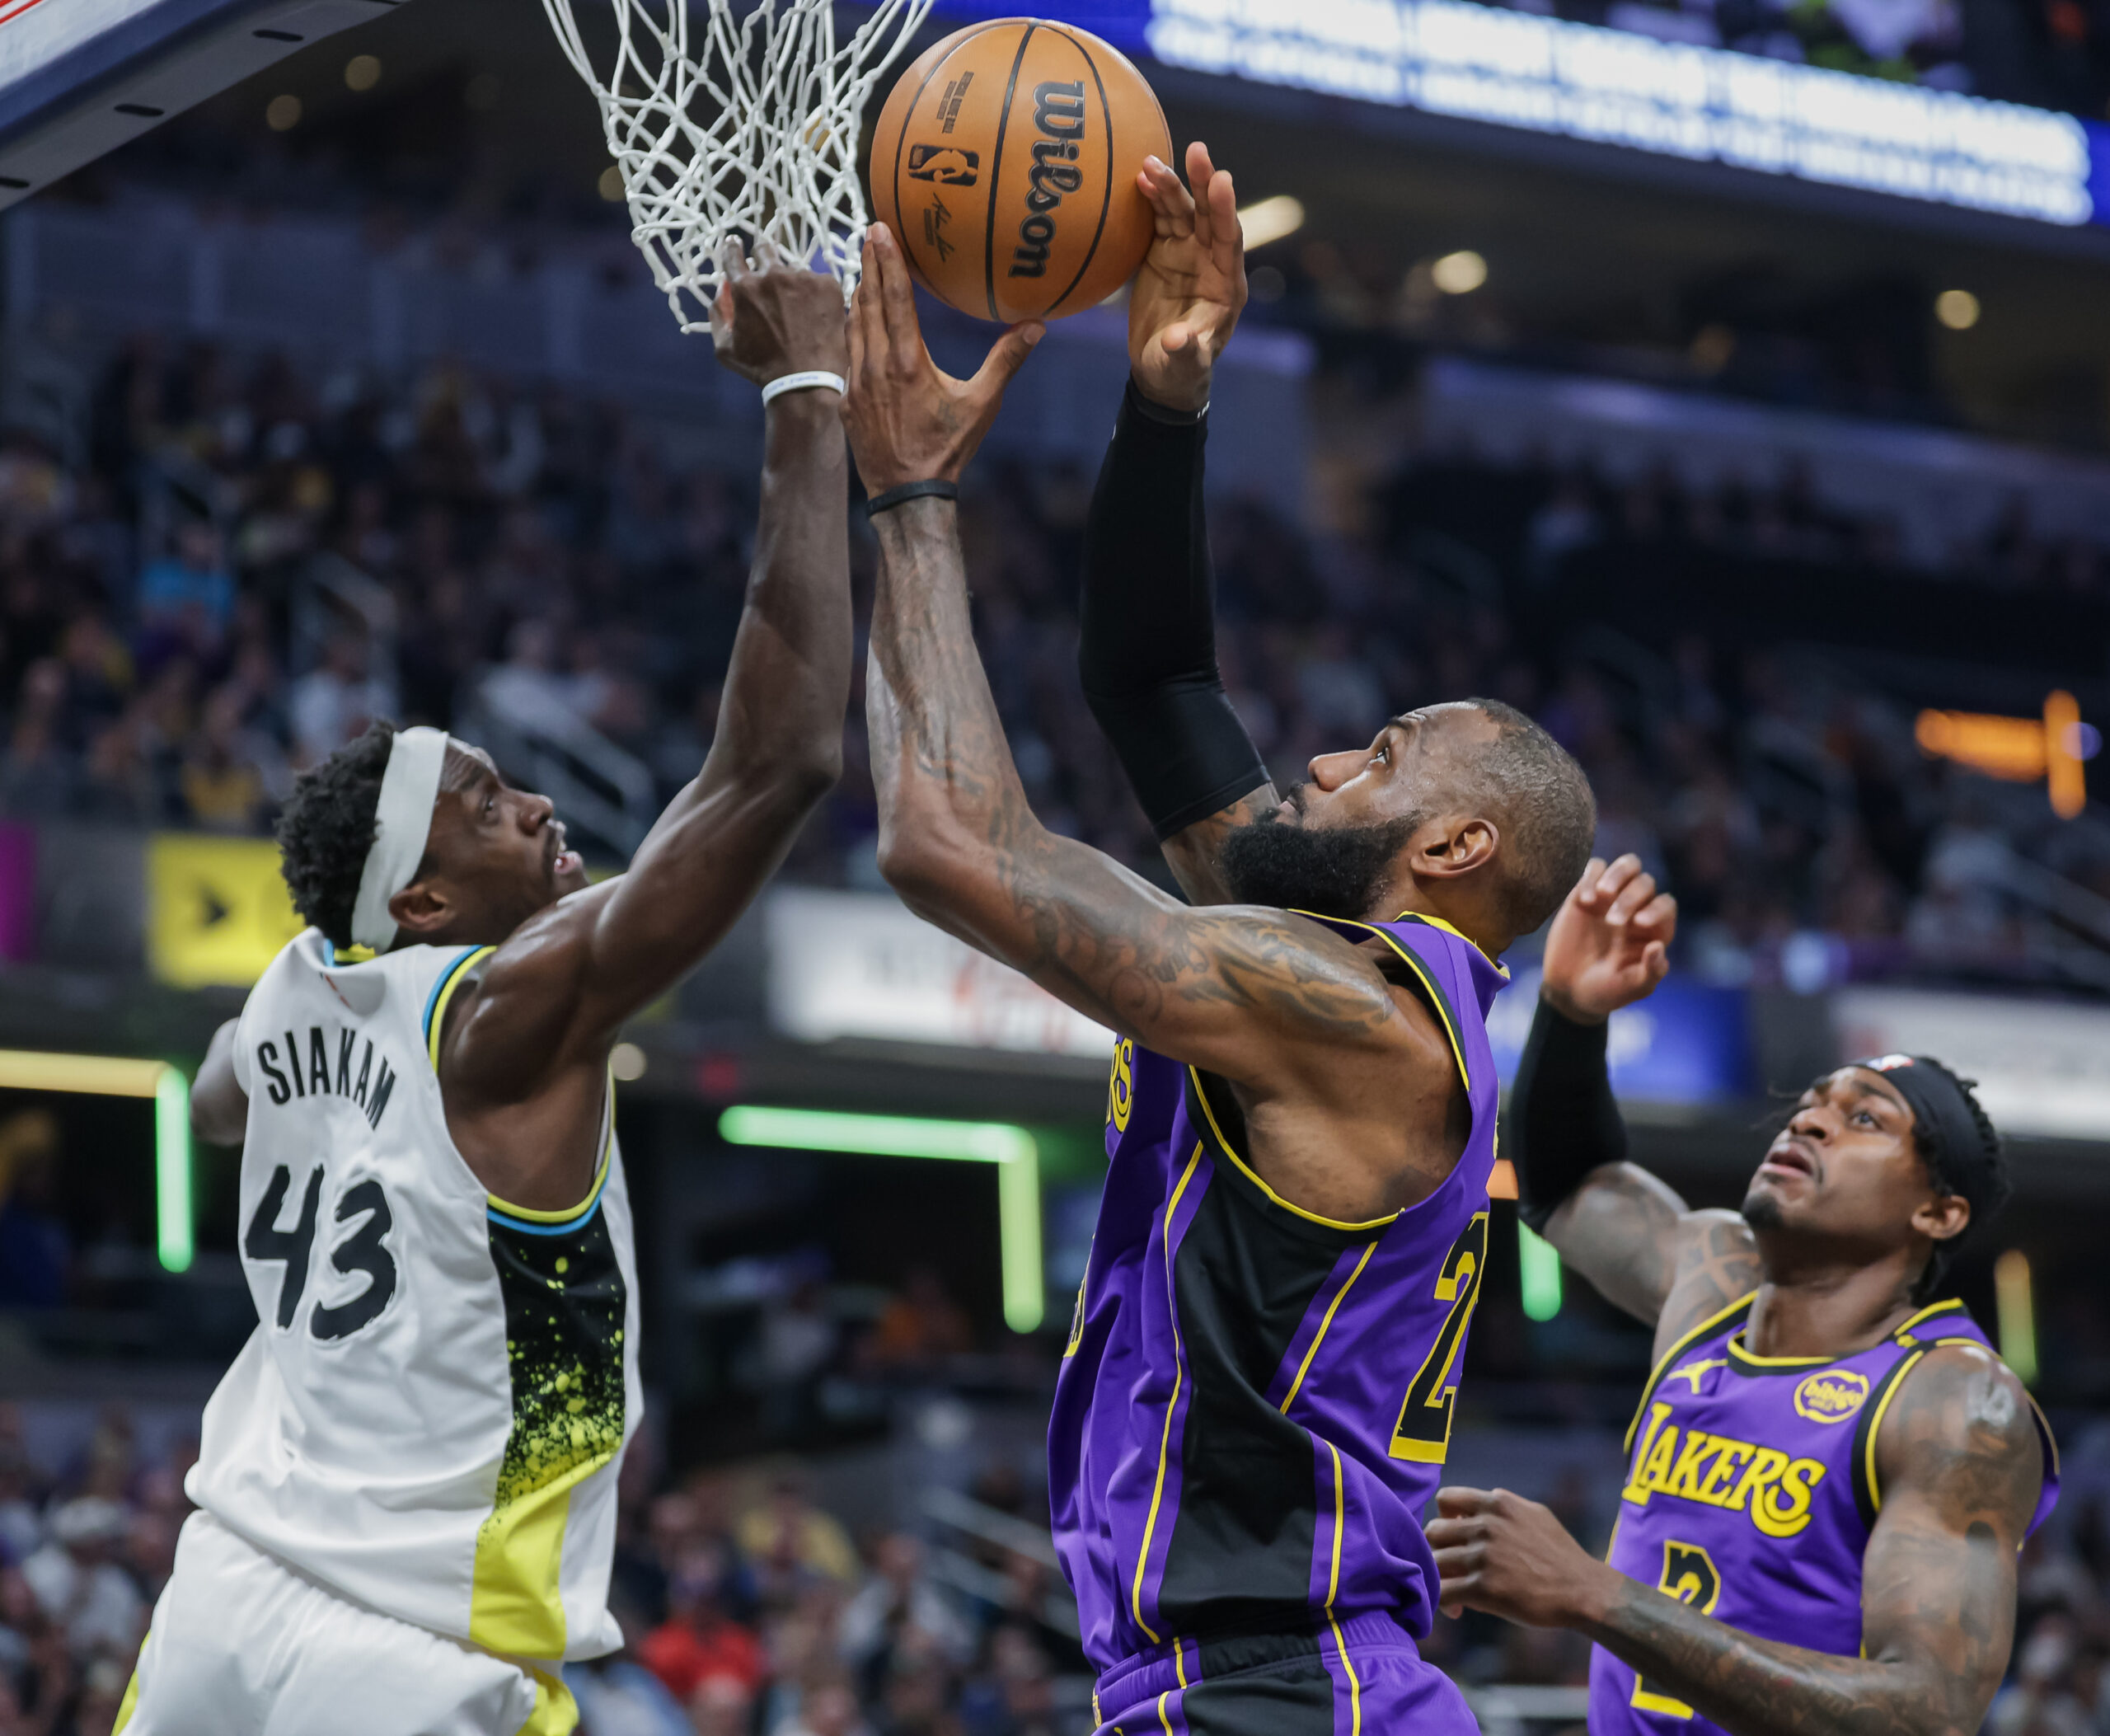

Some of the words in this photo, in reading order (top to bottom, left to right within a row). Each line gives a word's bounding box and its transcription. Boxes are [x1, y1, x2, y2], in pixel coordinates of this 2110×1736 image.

[1008, 81, 1085, 279] Wilson
[257, 1026, 396, 1131] SIAKAM
[245, 1163, 396, 1340] 43
[1622, 1402, 1826, 1537] LAKERS
